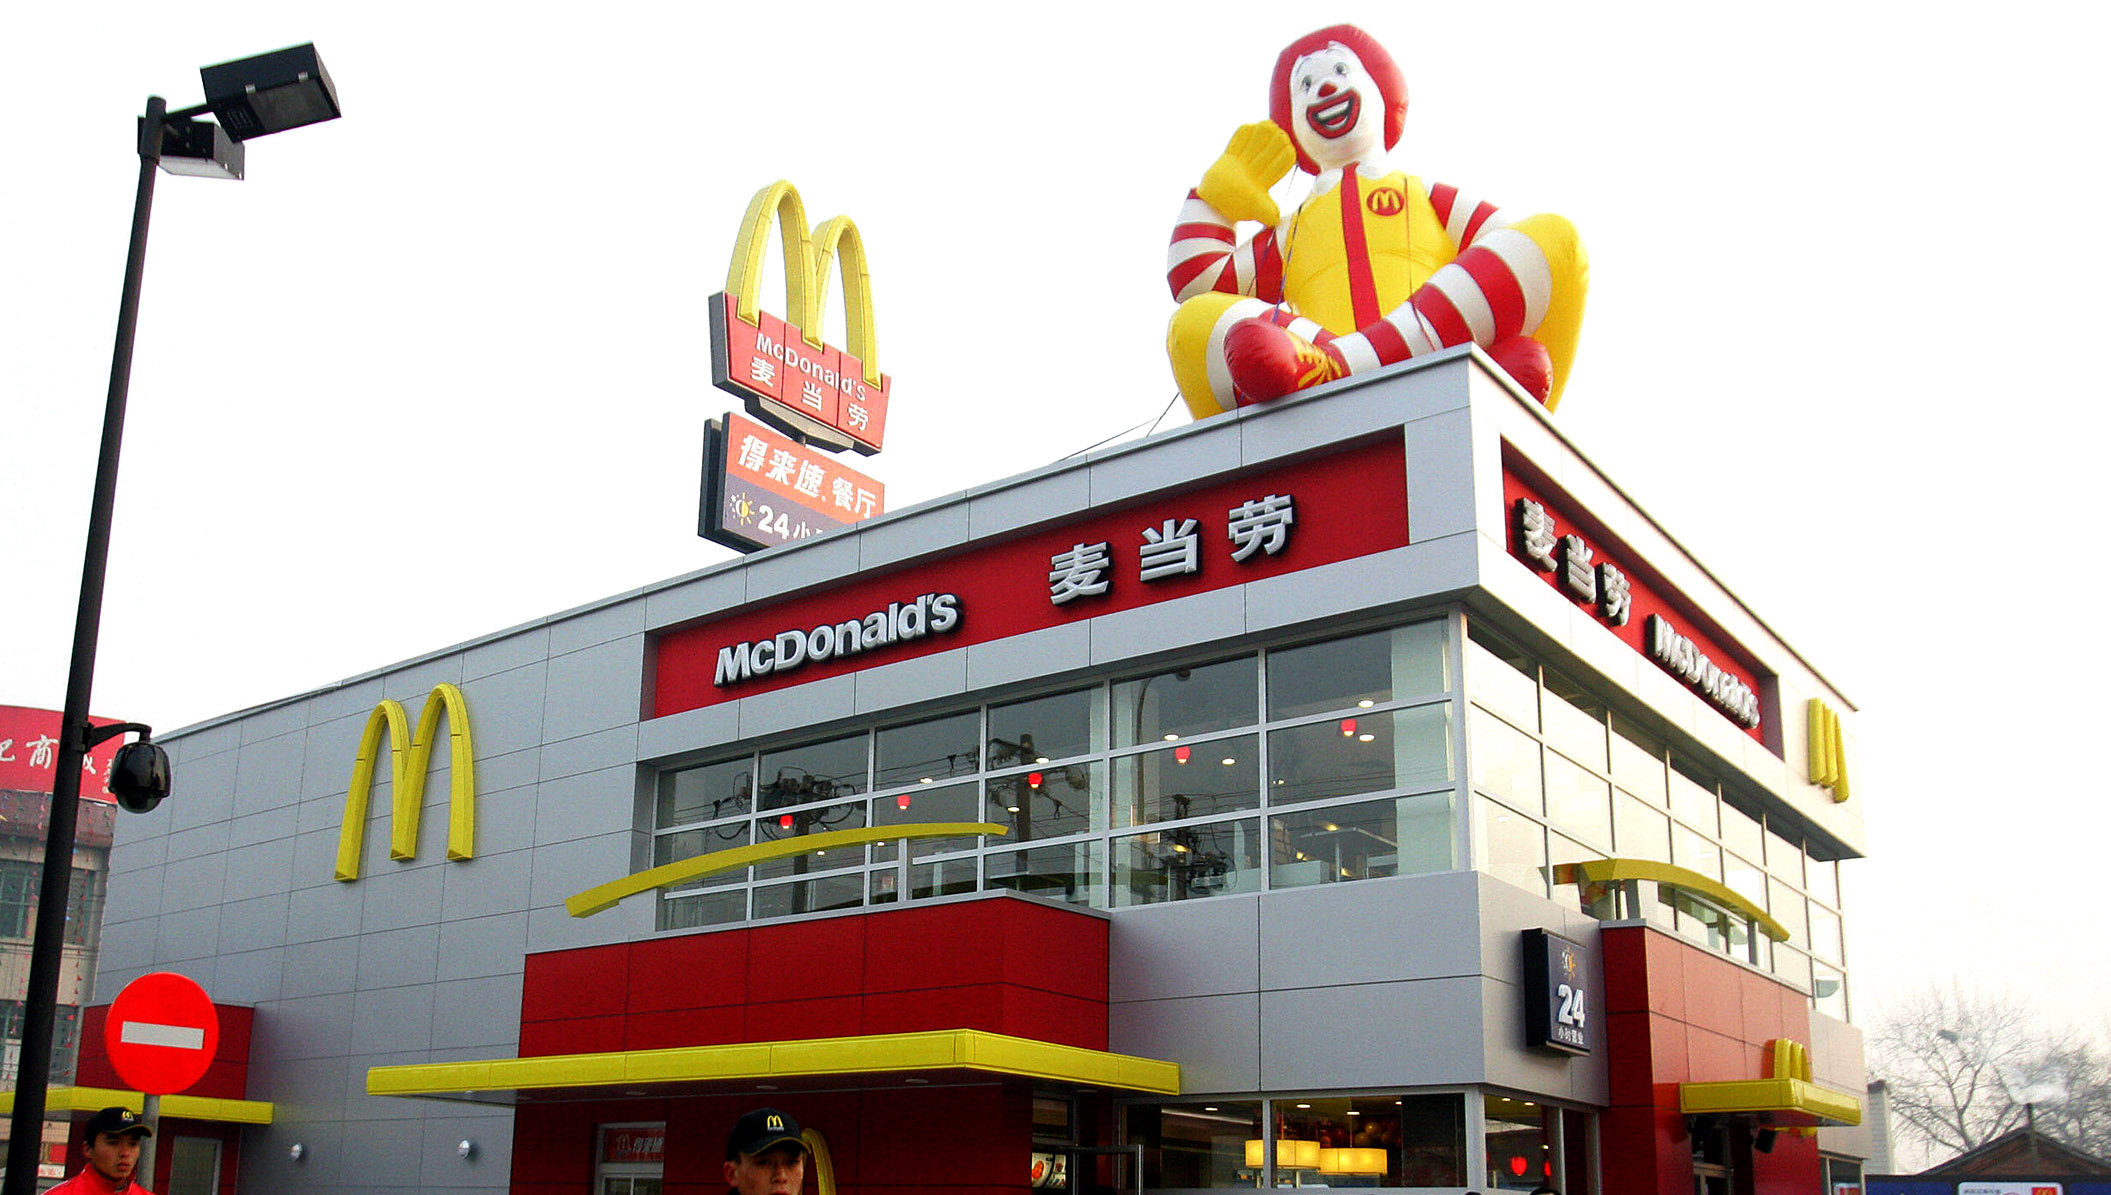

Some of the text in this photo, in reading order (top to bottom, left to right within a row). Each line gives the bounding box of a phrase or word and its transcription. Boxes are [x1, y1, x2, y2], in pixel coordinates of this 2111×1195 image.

[750, 356, 869, 431] 麦当劳
[756, 332, 866, 401] McDonald's
[1048, 494, 1293, 605] 麦当劳
[1520, 496, 1632, 627] 麦当劳
[713, 592, 961, 688] McDonald's
[1557, 983, 1586, 1029] 24
